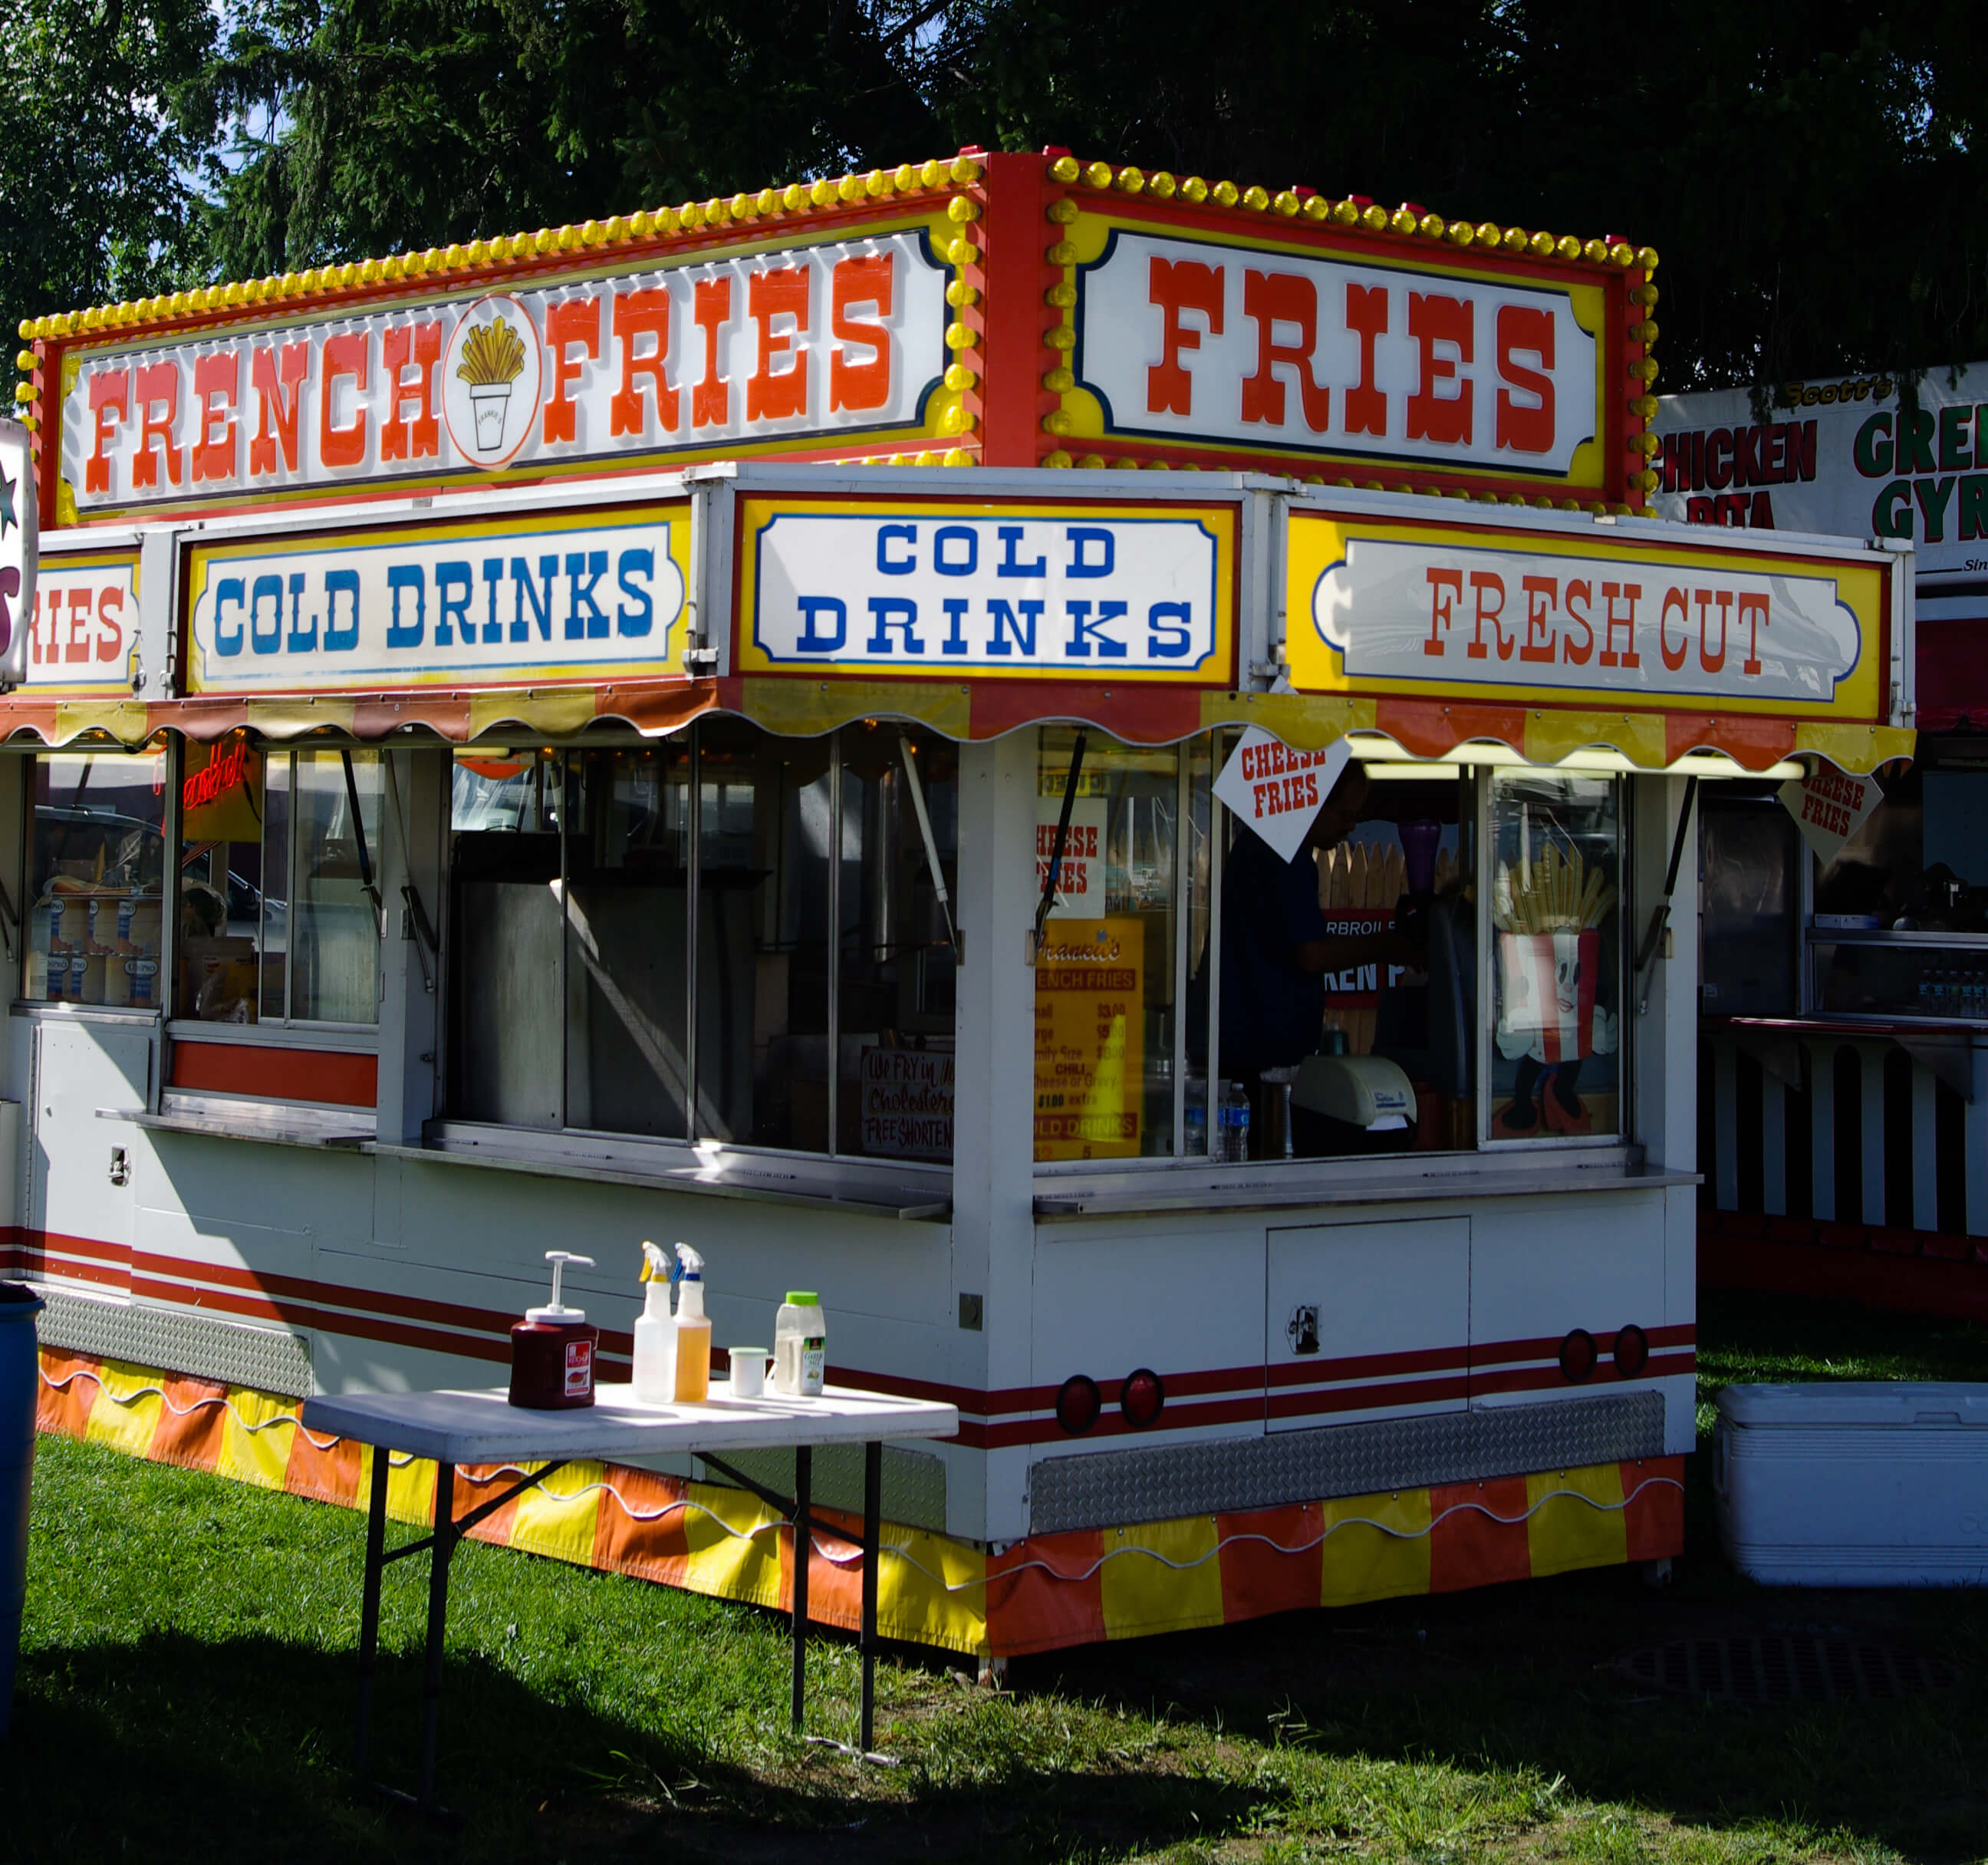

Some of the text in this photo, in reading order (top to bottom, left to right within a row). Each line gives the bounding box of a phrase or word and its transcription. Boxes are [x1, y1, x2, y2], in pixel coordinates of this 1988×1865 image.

[85, 251, 893, 495] FRENCH FRIES
[1147, 255, 1555, 453] FRIES
[876, 524, 1115, 579] COLD
[213, 545, 655, 657] COLD DRINKS
[796, 596, 1191, 658] DRINKS
[1424, 566, 1770, 676] FRESH CUT
[1253, 773, 1318, 819] FRIES
[1801, 794, 1850, 837] FRIES
[1086, 970, 1134, 989] FRIES
